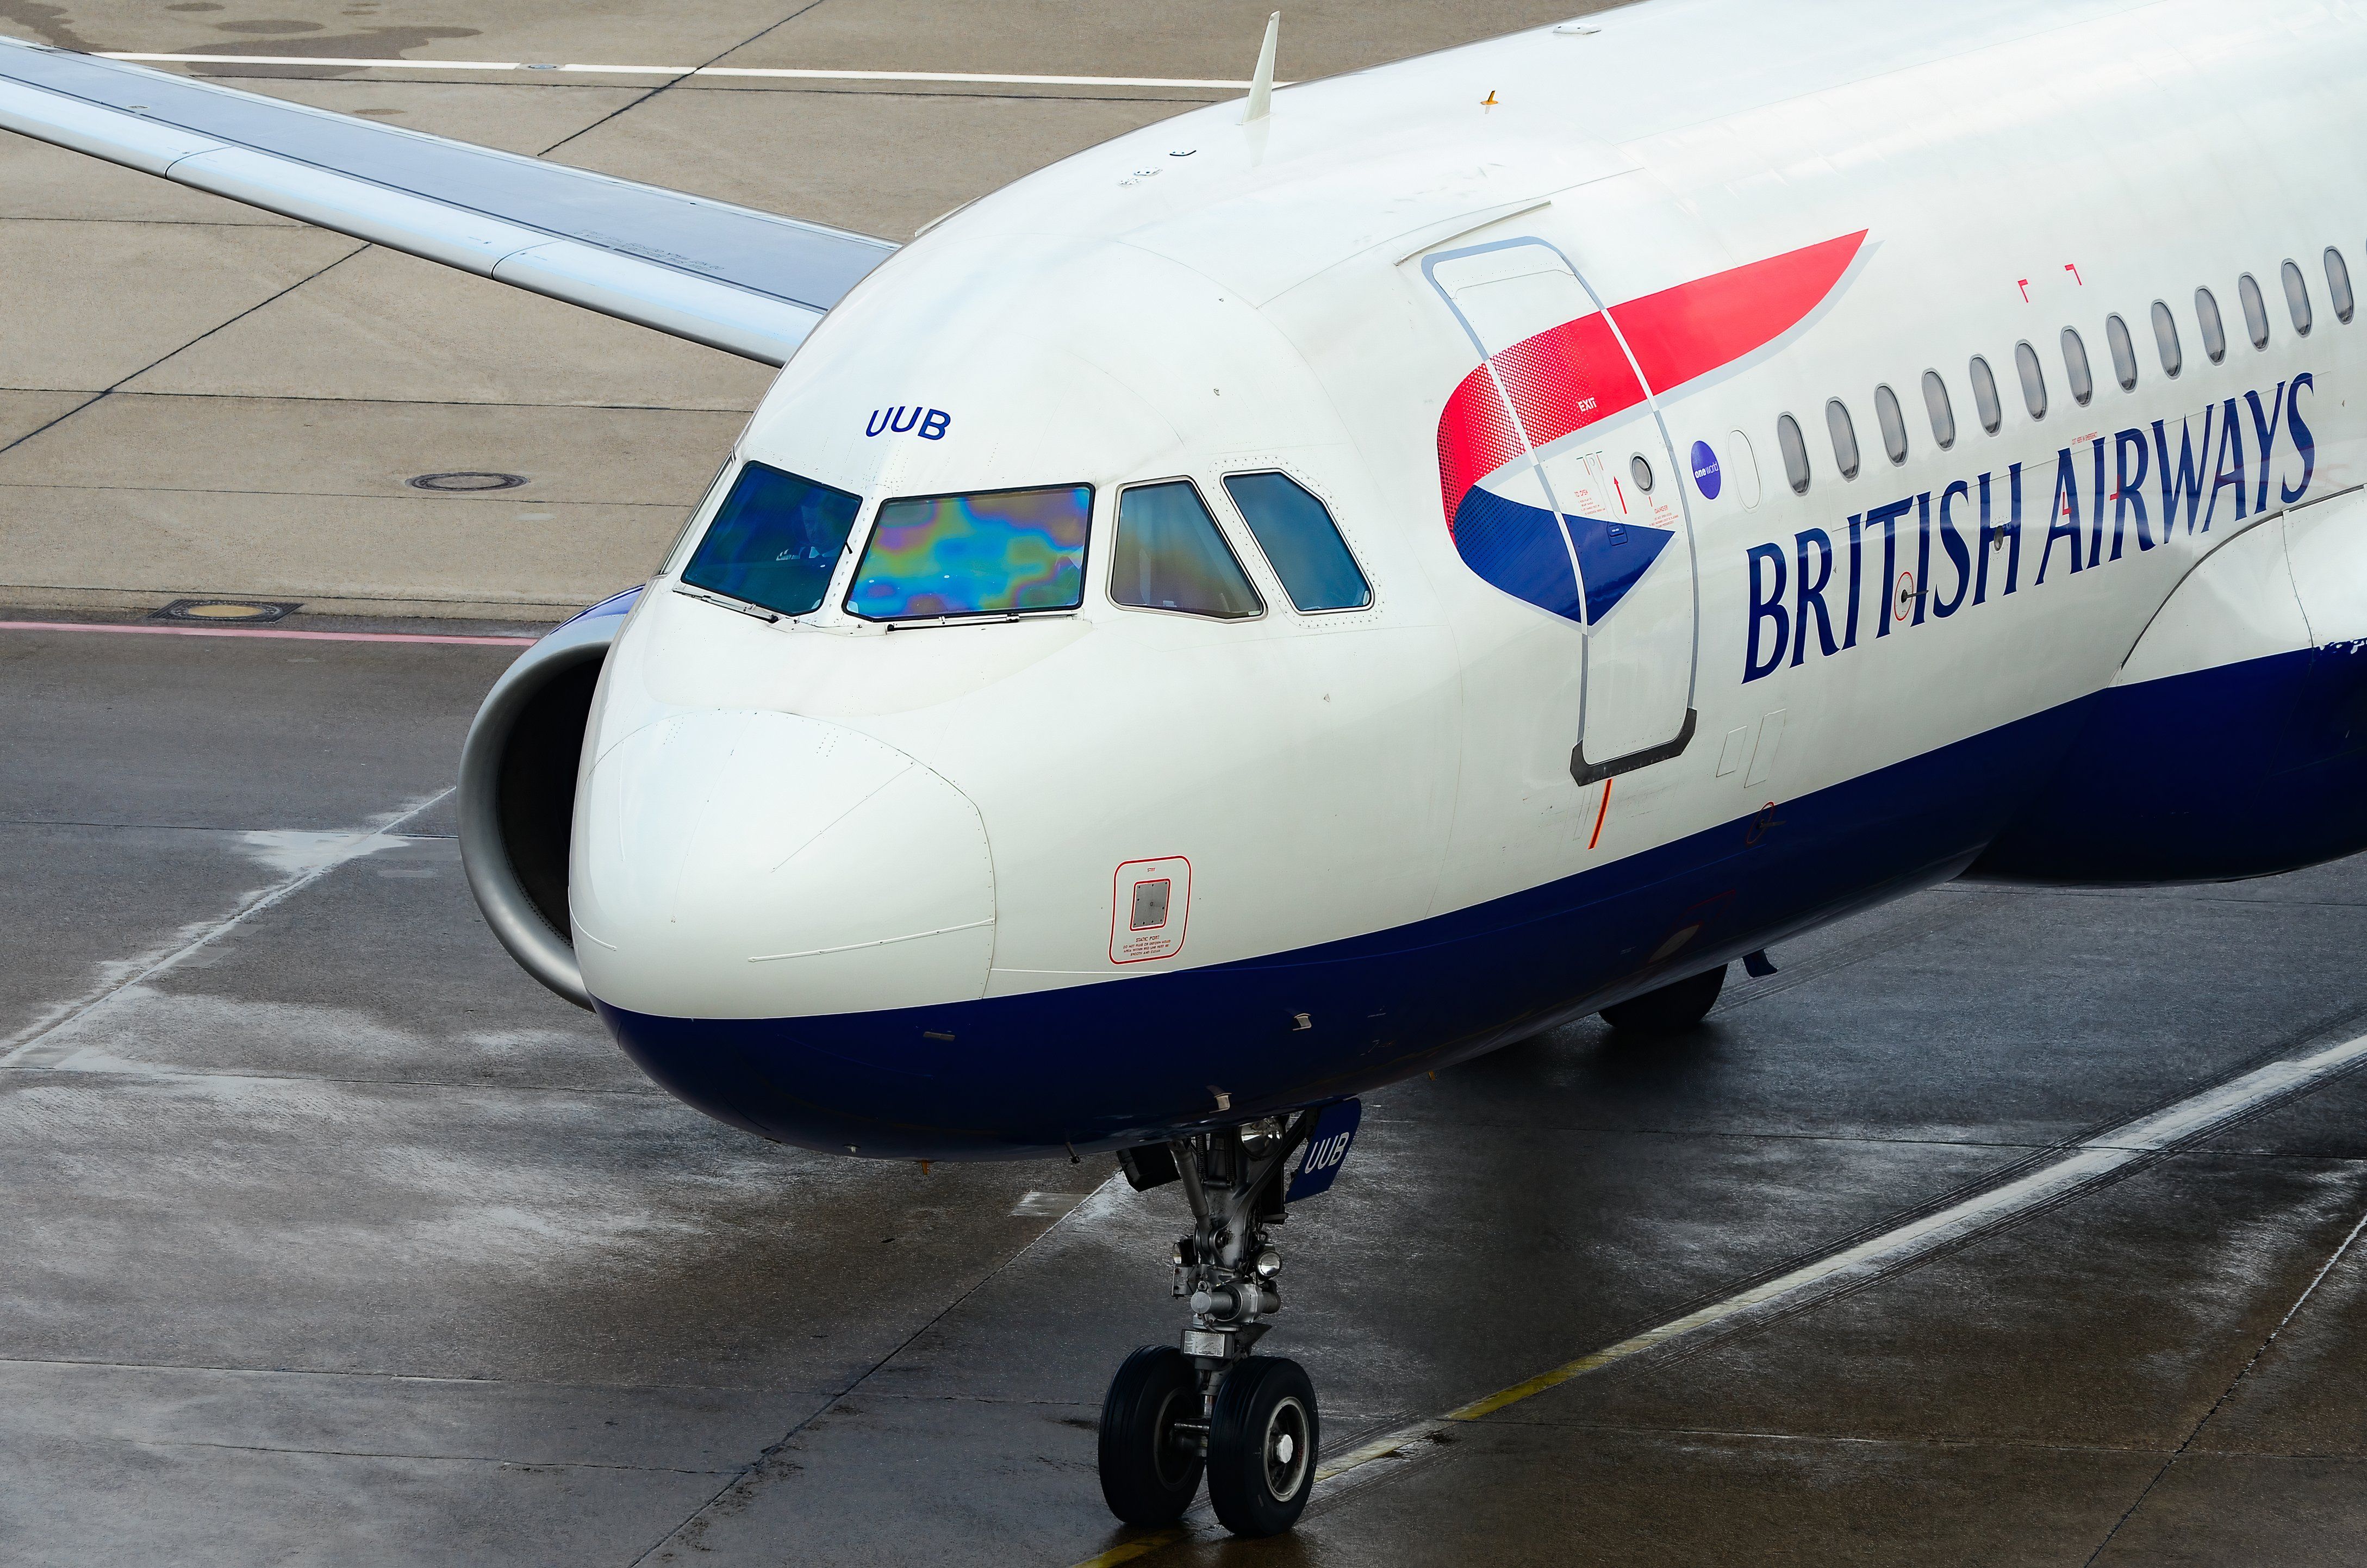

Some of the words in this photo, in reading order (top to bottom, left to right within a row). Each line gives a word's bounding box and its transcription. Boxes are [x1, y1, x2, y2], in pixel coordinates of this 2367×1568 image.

[865, 406, 951, 440] UUB
[1577, 397, 1597, 412] EXIT
[1741, 462, 2022, 684] BRITISH
[2034, 372, 2315, 586] AIRWAYS
[1305, 1132, 1349, 1174] UUB
